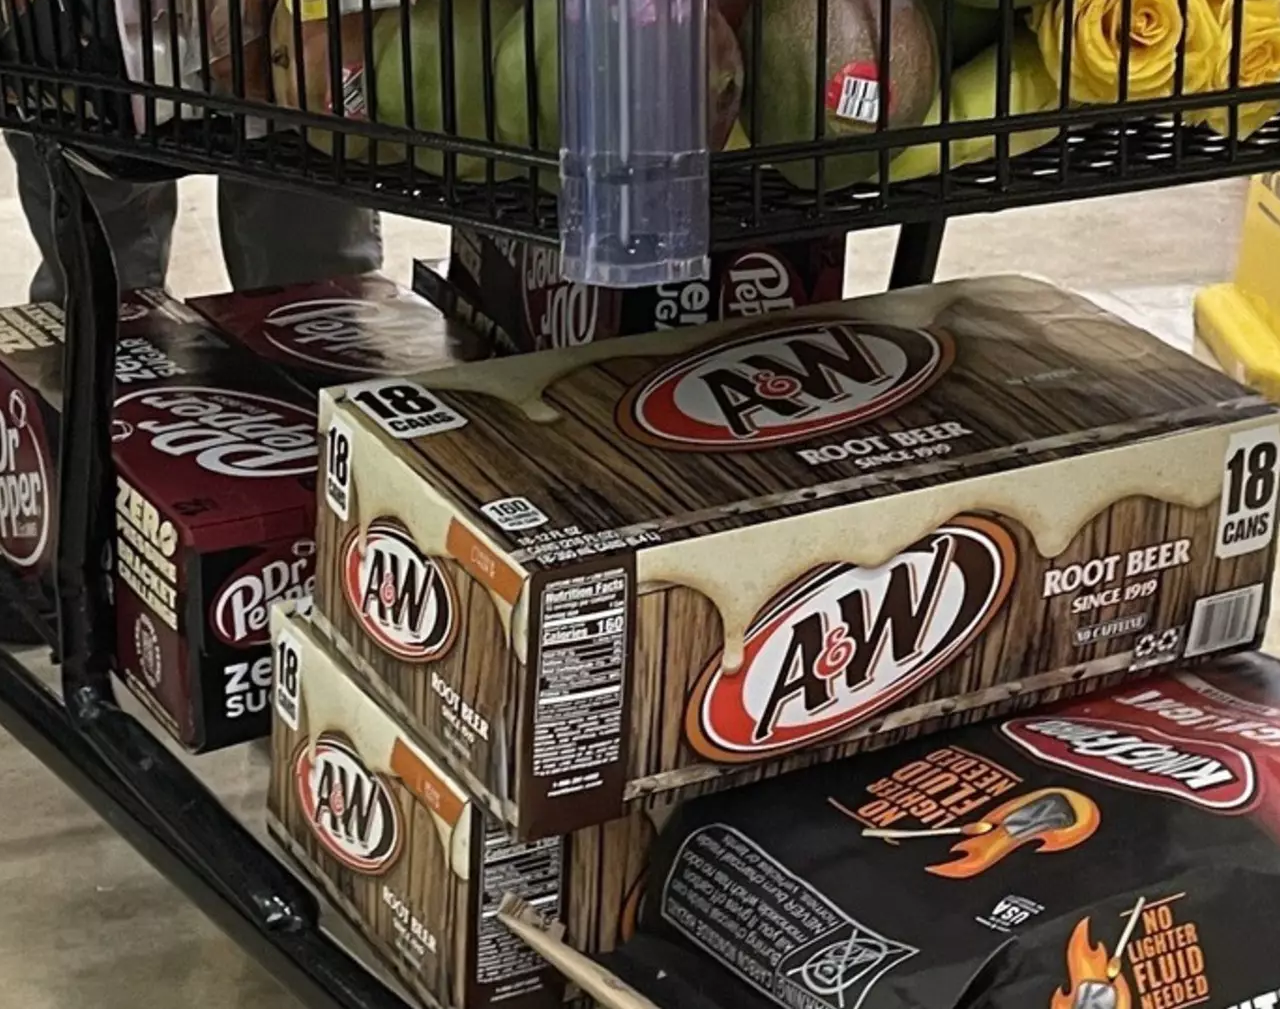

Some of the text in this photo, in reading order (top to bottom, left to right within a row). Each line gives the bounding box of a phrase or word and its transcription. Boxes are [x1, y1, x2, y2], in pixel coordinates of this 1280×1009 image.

[700, 322, 892, 438] A&W
[356, 385, 441, 420] 18
[388, 410, 455, 433] CANS
[327, 426, 349, 480] 18
[796, 421, 973, 466] ROOT BEER
[1226, 441, 1277, 515] 18
[489, 498, 528, 517] 160
[1221, 513, 1270, 546] CANS
[262, 559, 307, 600] Dr
[363, 547, 436, 629] A&W
[1043, 539, 1191, 598] ROOT BEER
[1071, 579, 1158, 613] SINCE 1919
[751, 533, 957, 741] A&W
[224, 657, 272, 694] ze
[278, 641, 298, 697] 18
[891, 762, 991, 814] FLUID
[924, 748, 1020, 794] NEEDED
[315, 757, 378, 846] A&W
[856, 800, 908, 829] NO
[992, 900, 1030, 925] USA
[1142, 905, 1173, 935] NO
[1127, 923, 1198, 964] LIGHTER
[1133, 945, 1204, 994] FLUID
[1140, 974, 1209, 1009] NEEDED
